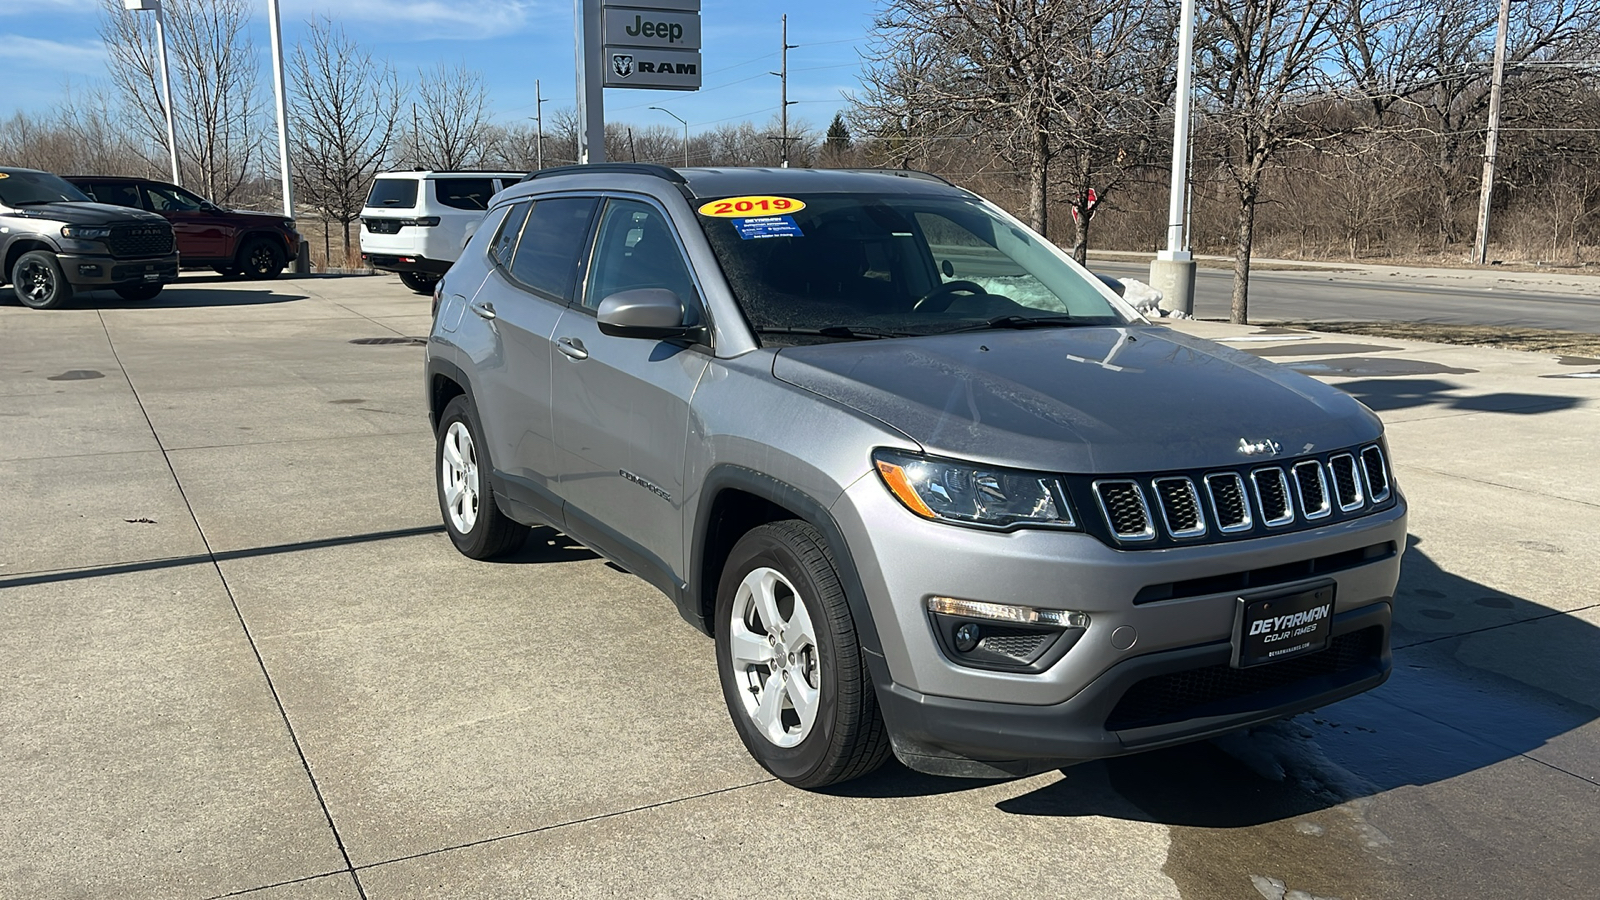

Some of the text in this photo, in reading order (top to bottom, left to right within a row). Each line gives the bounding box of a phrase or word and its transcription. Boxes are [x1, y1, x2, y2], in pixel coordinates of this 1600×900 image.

[626, 15, 683, 43] Jeep
[638, 61, 697, 75] RAM
[714, 199, 792, 215] 2019
[619, 468, 671, 502] COMPASS
[1249, 604, 1331, 636] DEYARMAN
[1294, 623, 1318, 637] AMES
